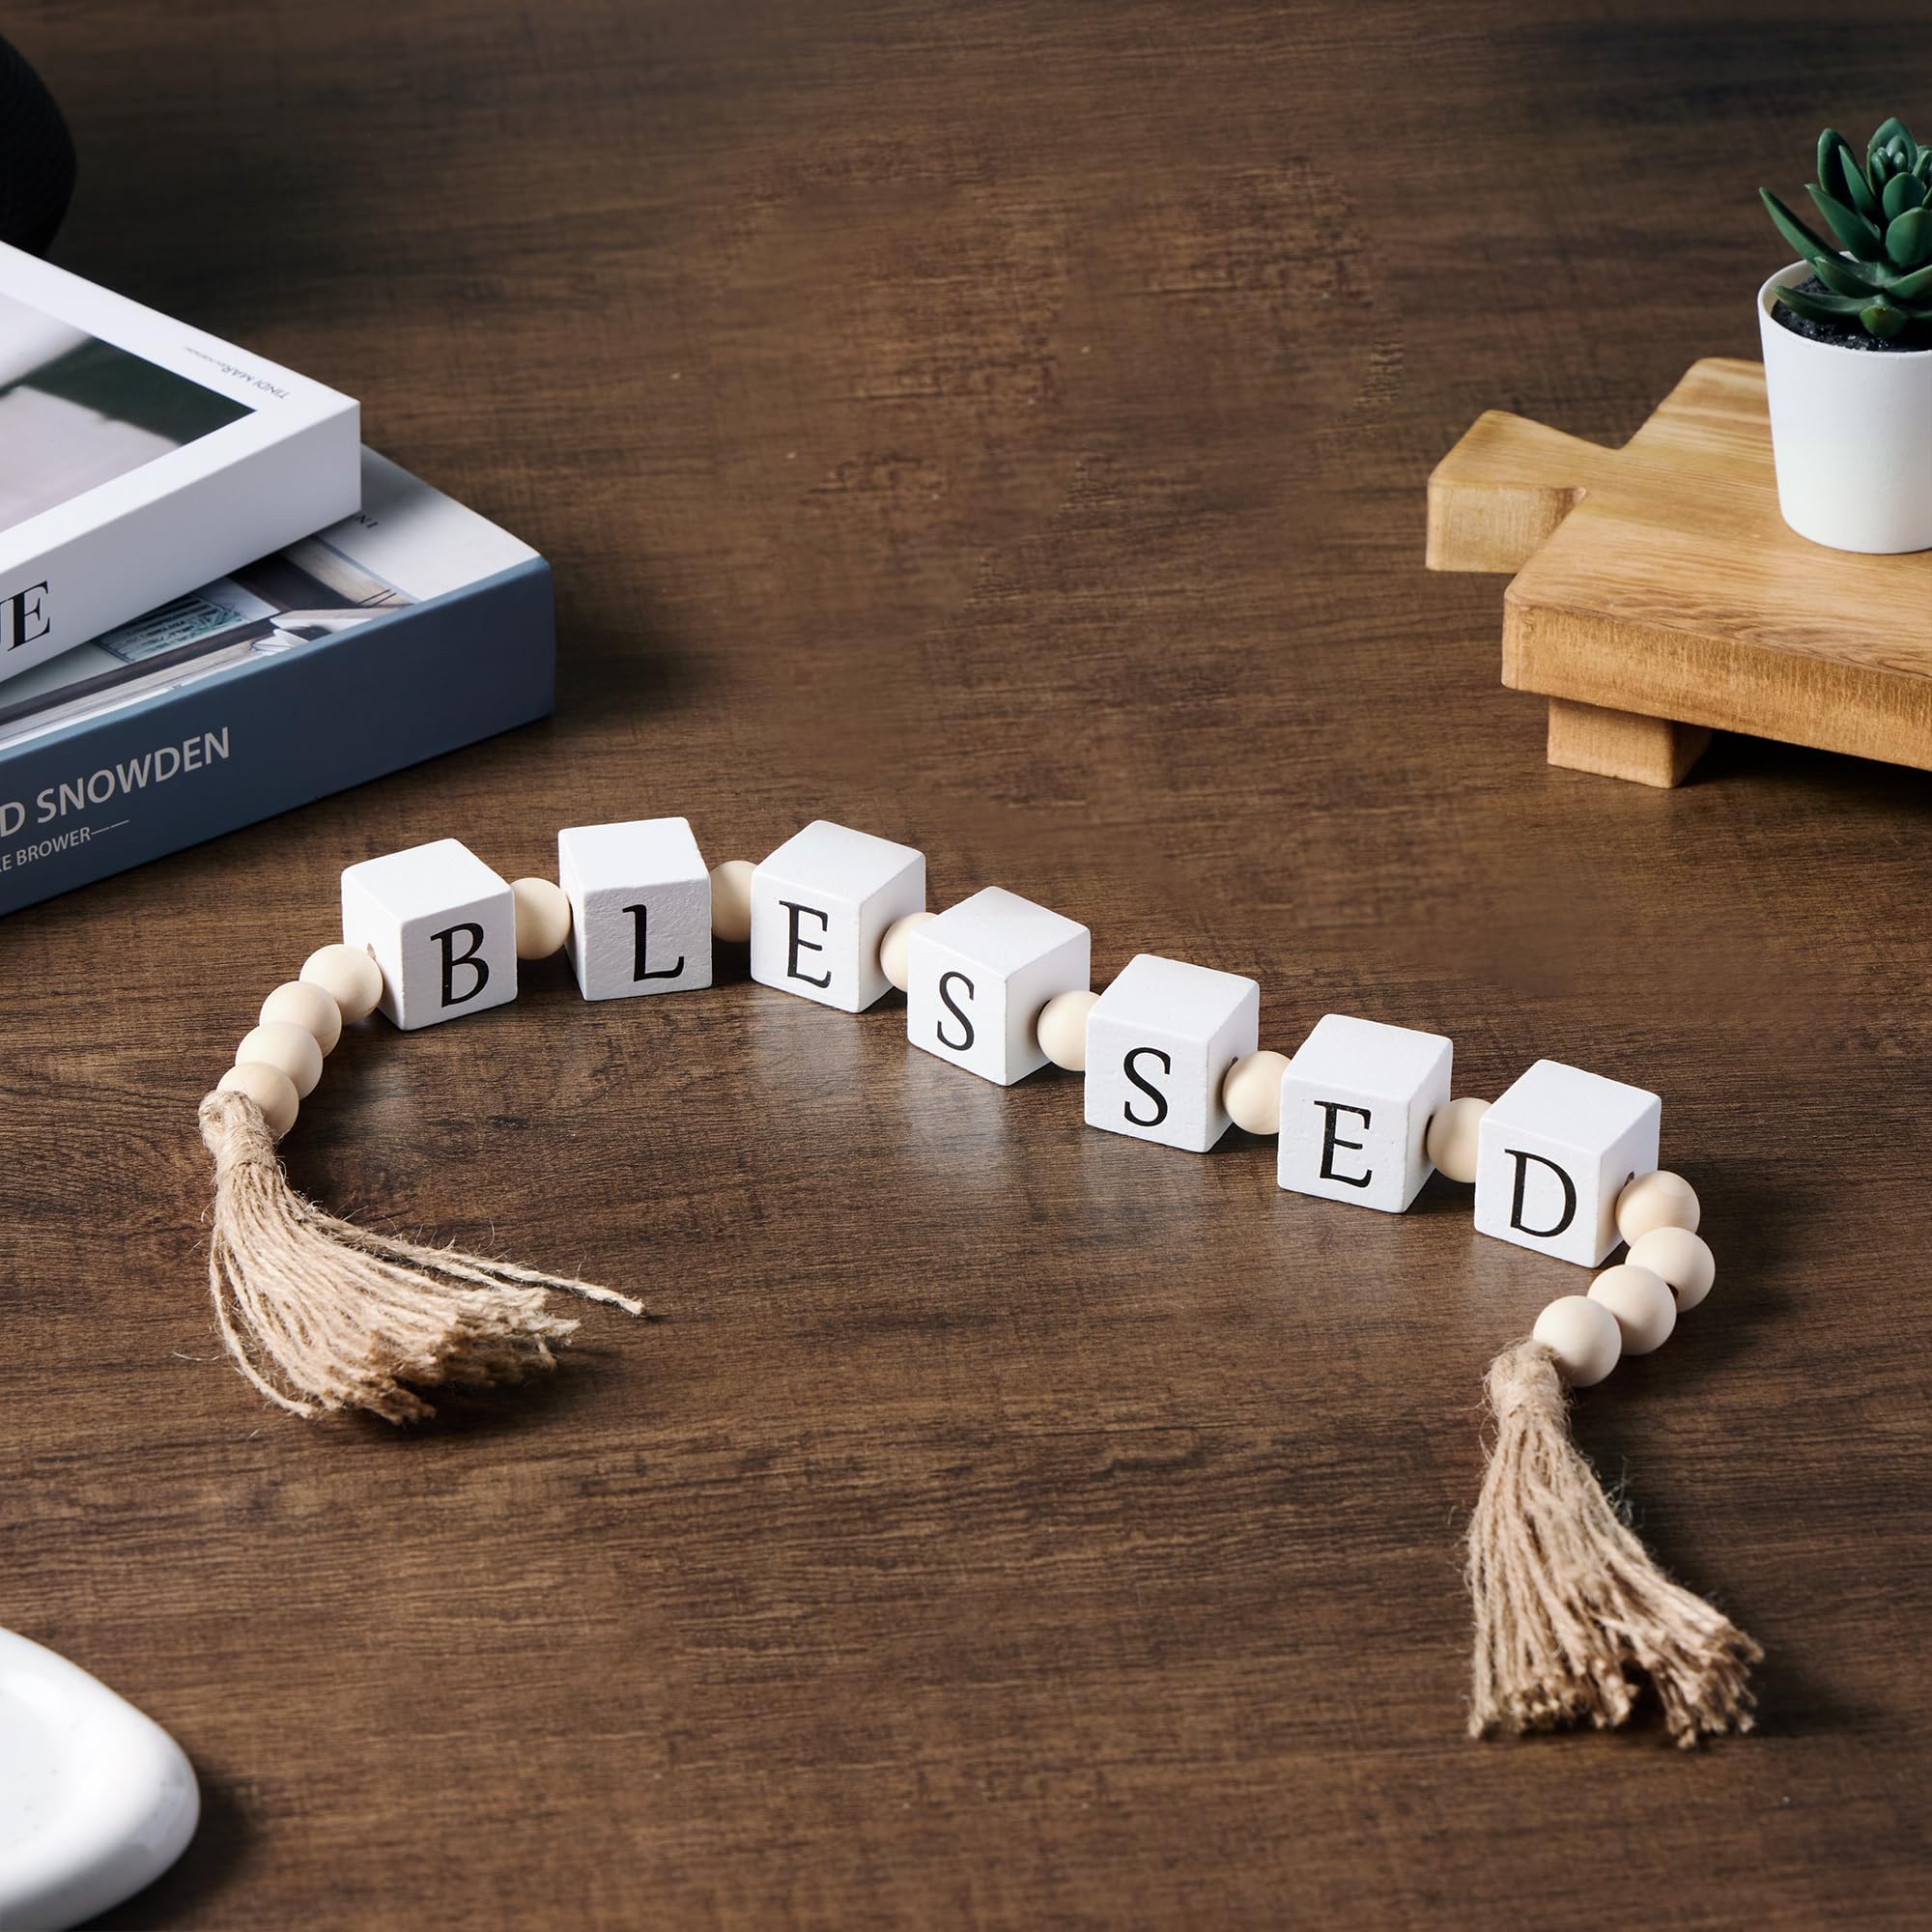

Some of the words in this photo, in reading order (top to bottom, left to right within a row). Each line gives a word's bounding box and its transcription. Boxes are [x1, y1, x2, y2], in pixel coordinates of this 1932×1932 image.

[0, 580, 50, 652] E
[36, 726, 230, 823] SNOWDEN
[16, 826, 92, 867] BROWER
